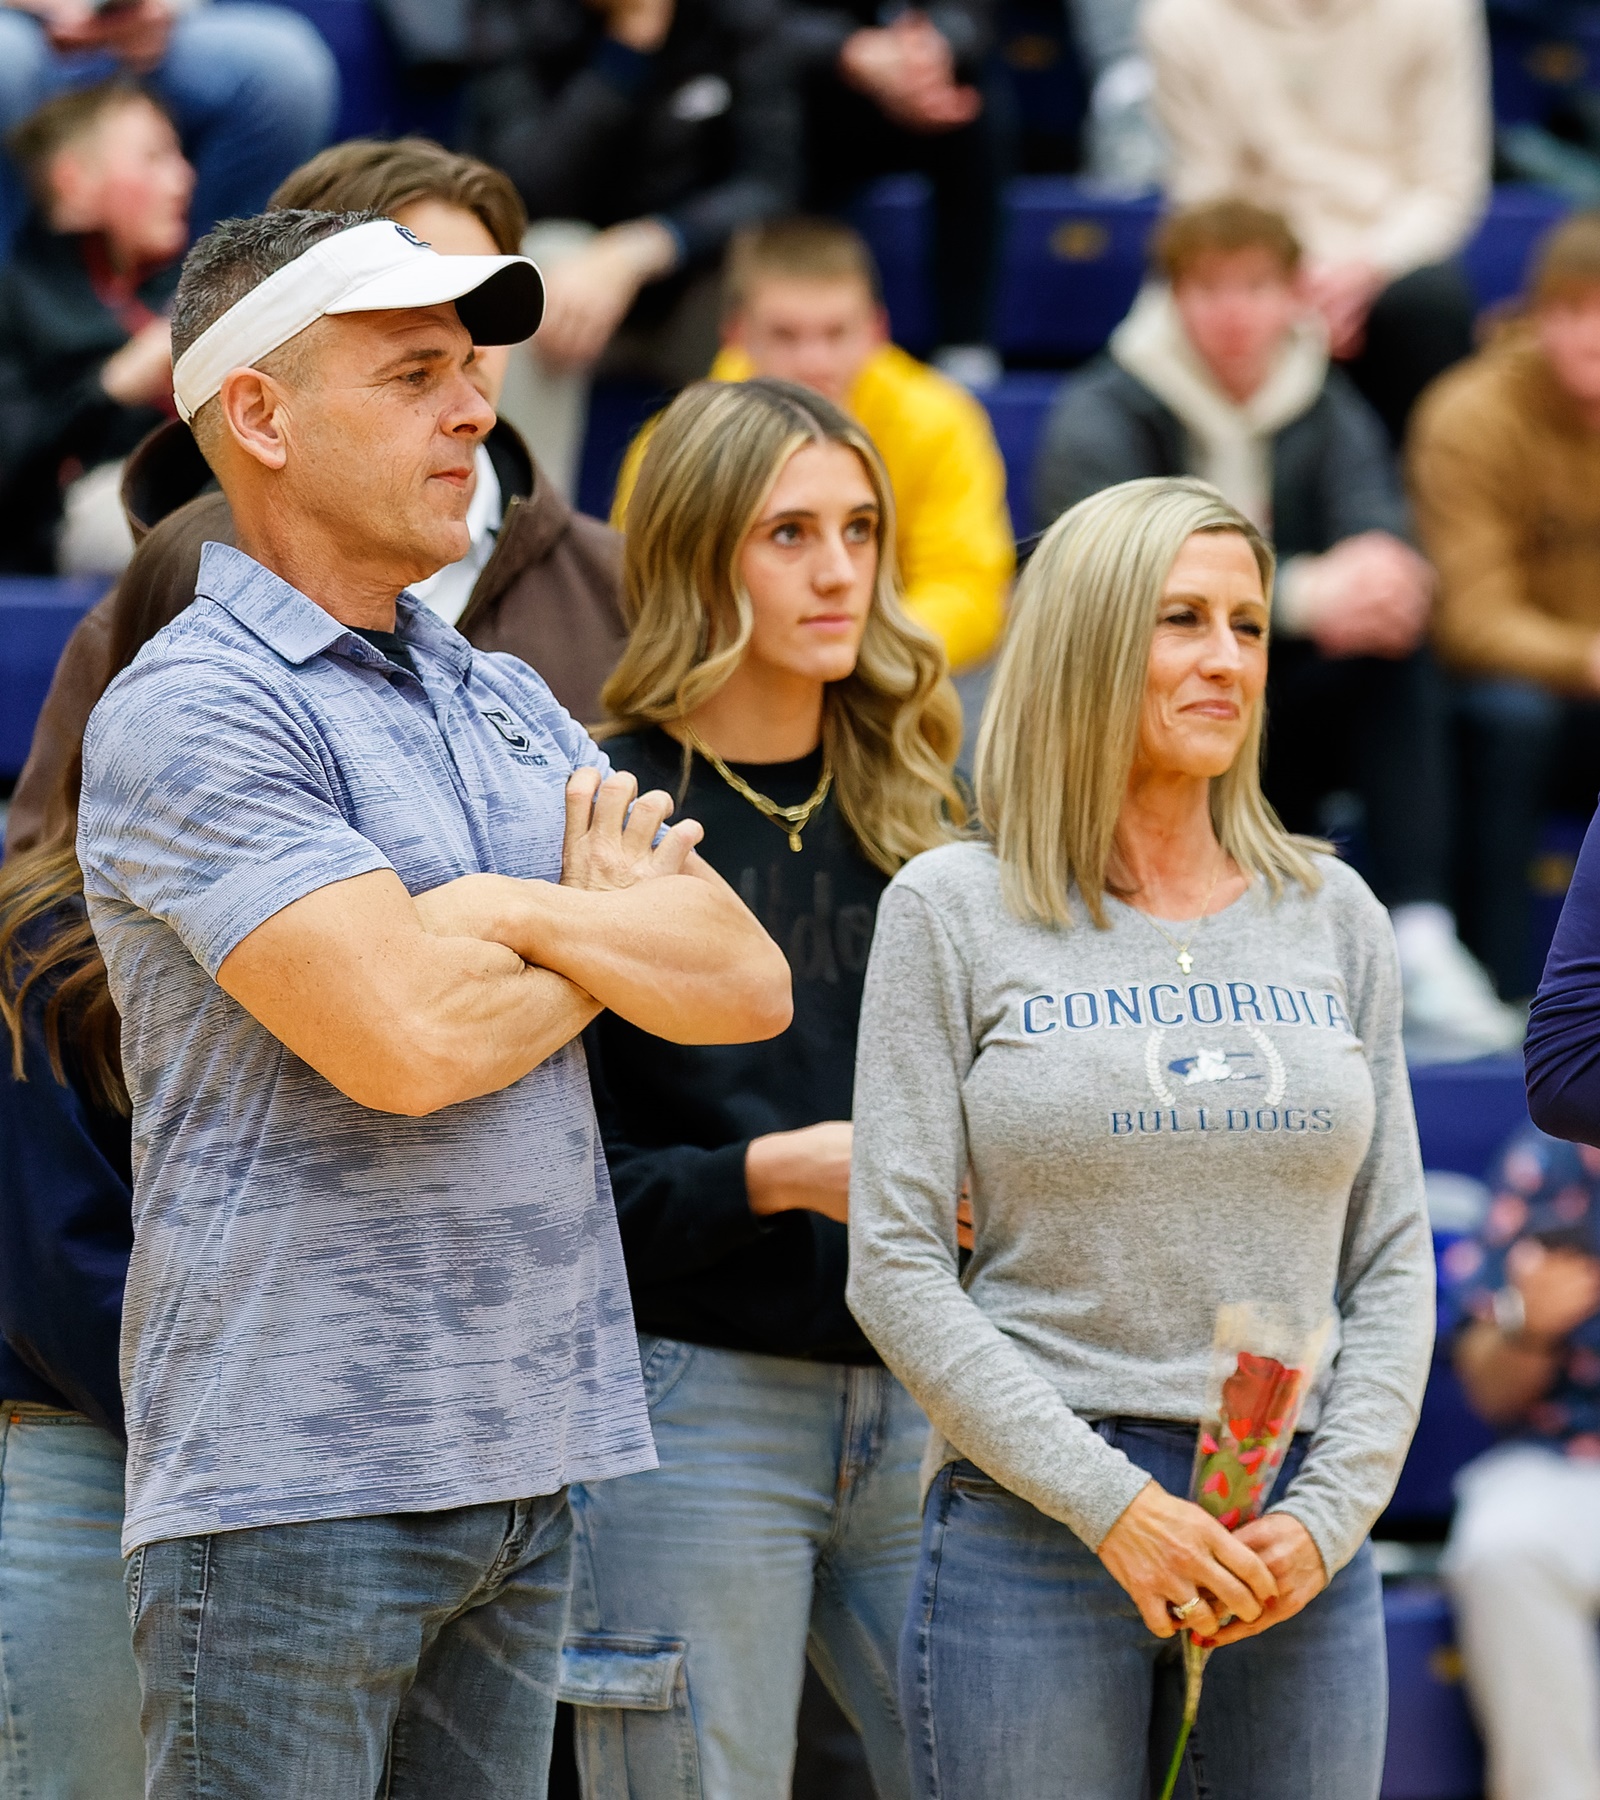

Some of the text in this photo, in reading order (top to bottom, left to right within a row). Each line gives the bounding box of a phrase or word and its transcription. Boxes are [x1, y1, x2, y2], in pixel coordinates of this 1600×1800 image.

[480, 707, 530, 752] C
[1021, 979, 1357, 1037] CONCORDIA
[1109, 1107, 1335, 1137] BULLDOGS
